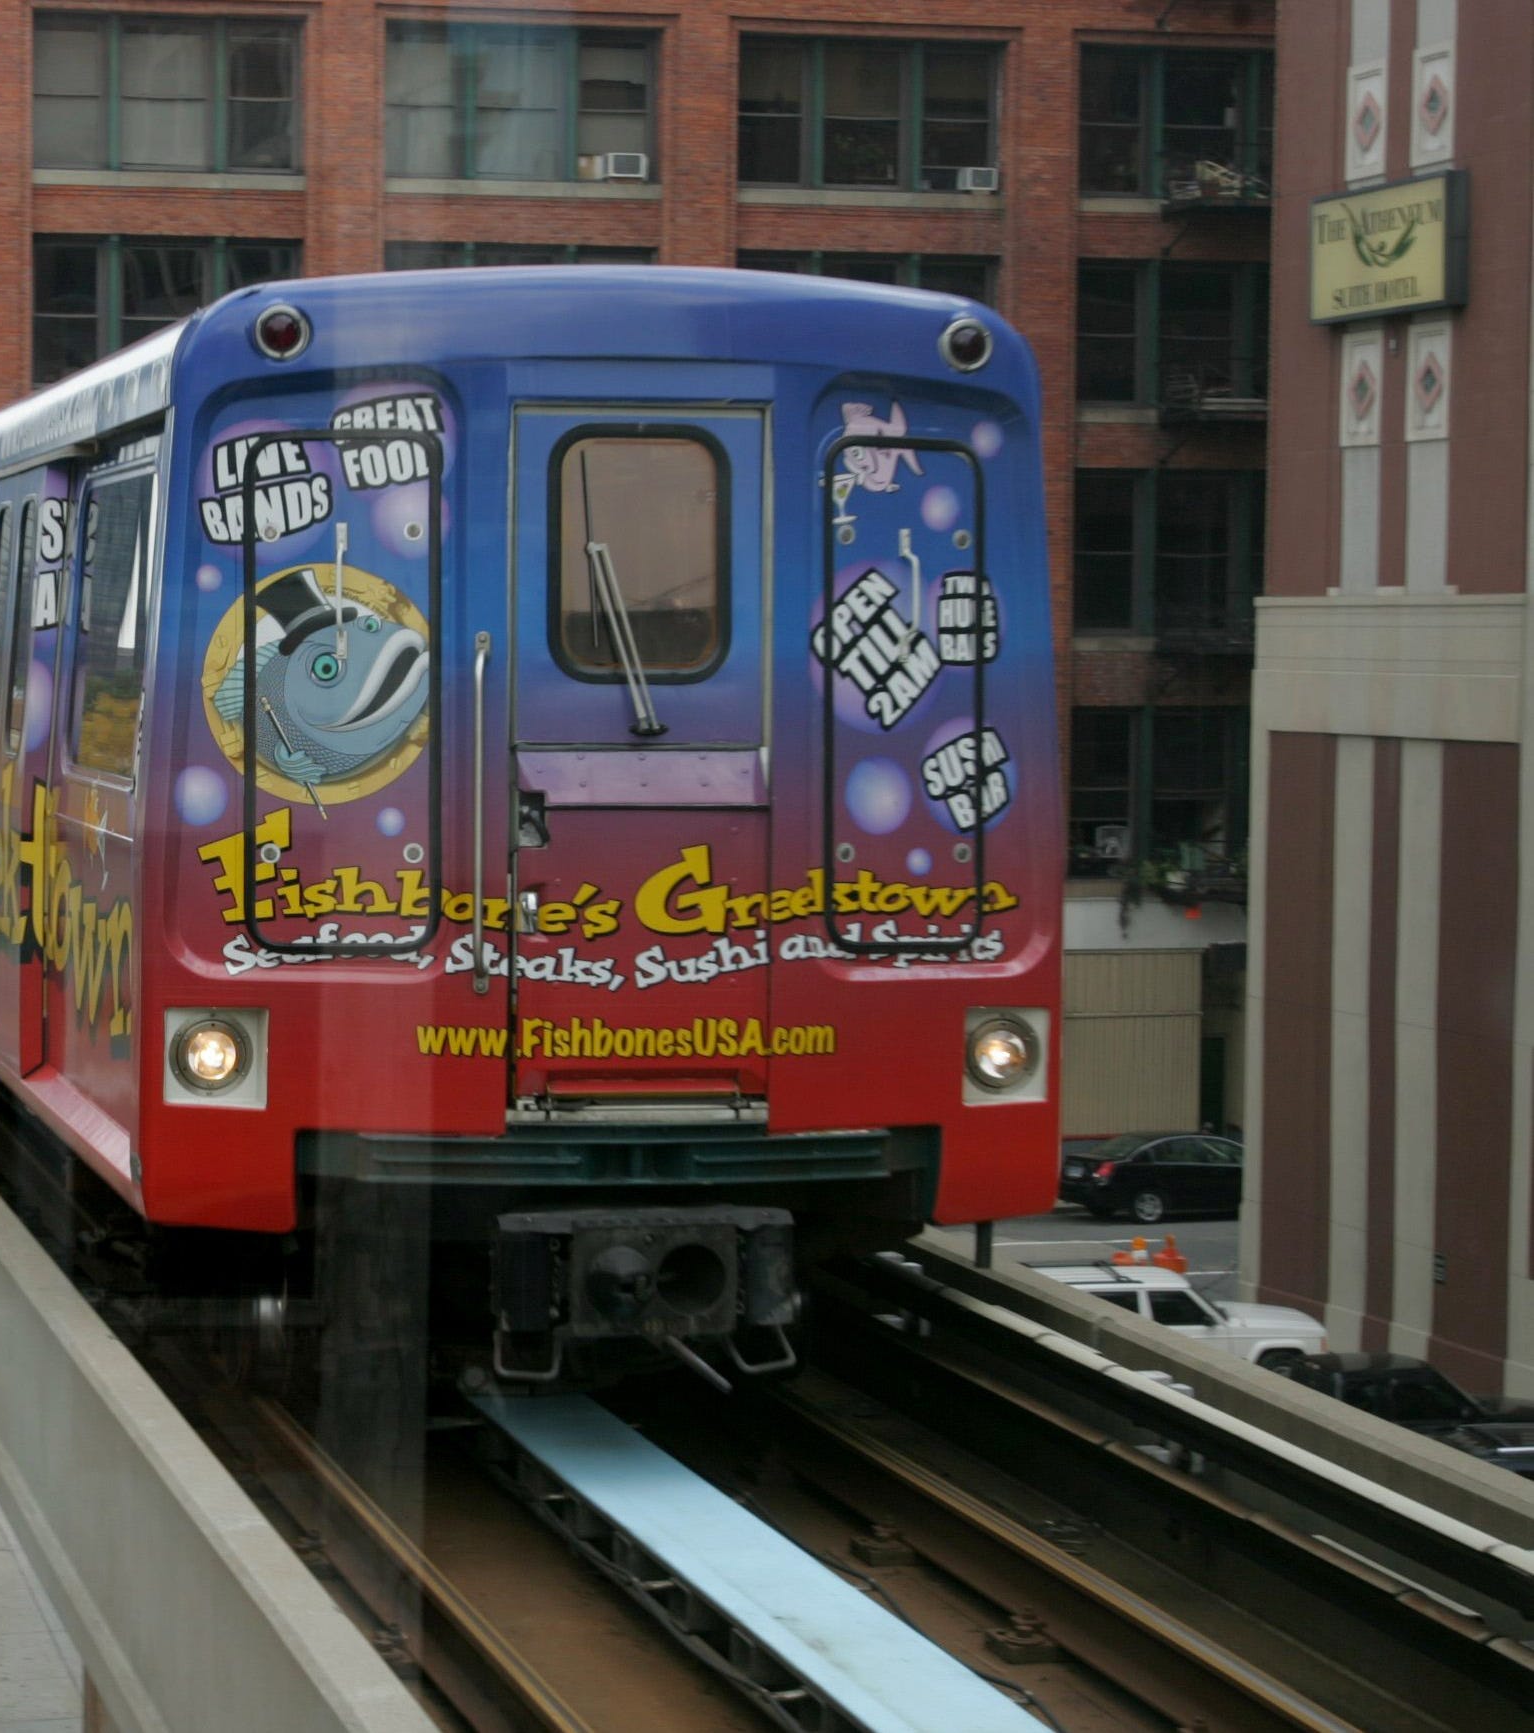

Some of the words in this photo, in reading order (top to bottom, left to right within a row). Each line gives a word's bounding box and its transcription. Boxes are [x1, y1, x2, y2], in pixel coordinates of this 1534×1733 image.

[332, 396, 438, 446] GREAT
[215, 435, 308, 490] LIVE
[201, 475, 330, 542] BANDS
[813, 571, 897, 662] OPEN
[838, 608, 917, 691] TILL
[867, 637, 942, 727] 2AM
[922, 730, 1007, 797] SUSHI
[197, 807, 621, 939] Fishbone's
[634, 844, 1019, 934] Greektown
[222, 922, 435, 976] Seafood,
[445, 932, 626, 992] Steaks,
[634, 930, 769, 989] Sushi
[778, 922, 862, 961] and
